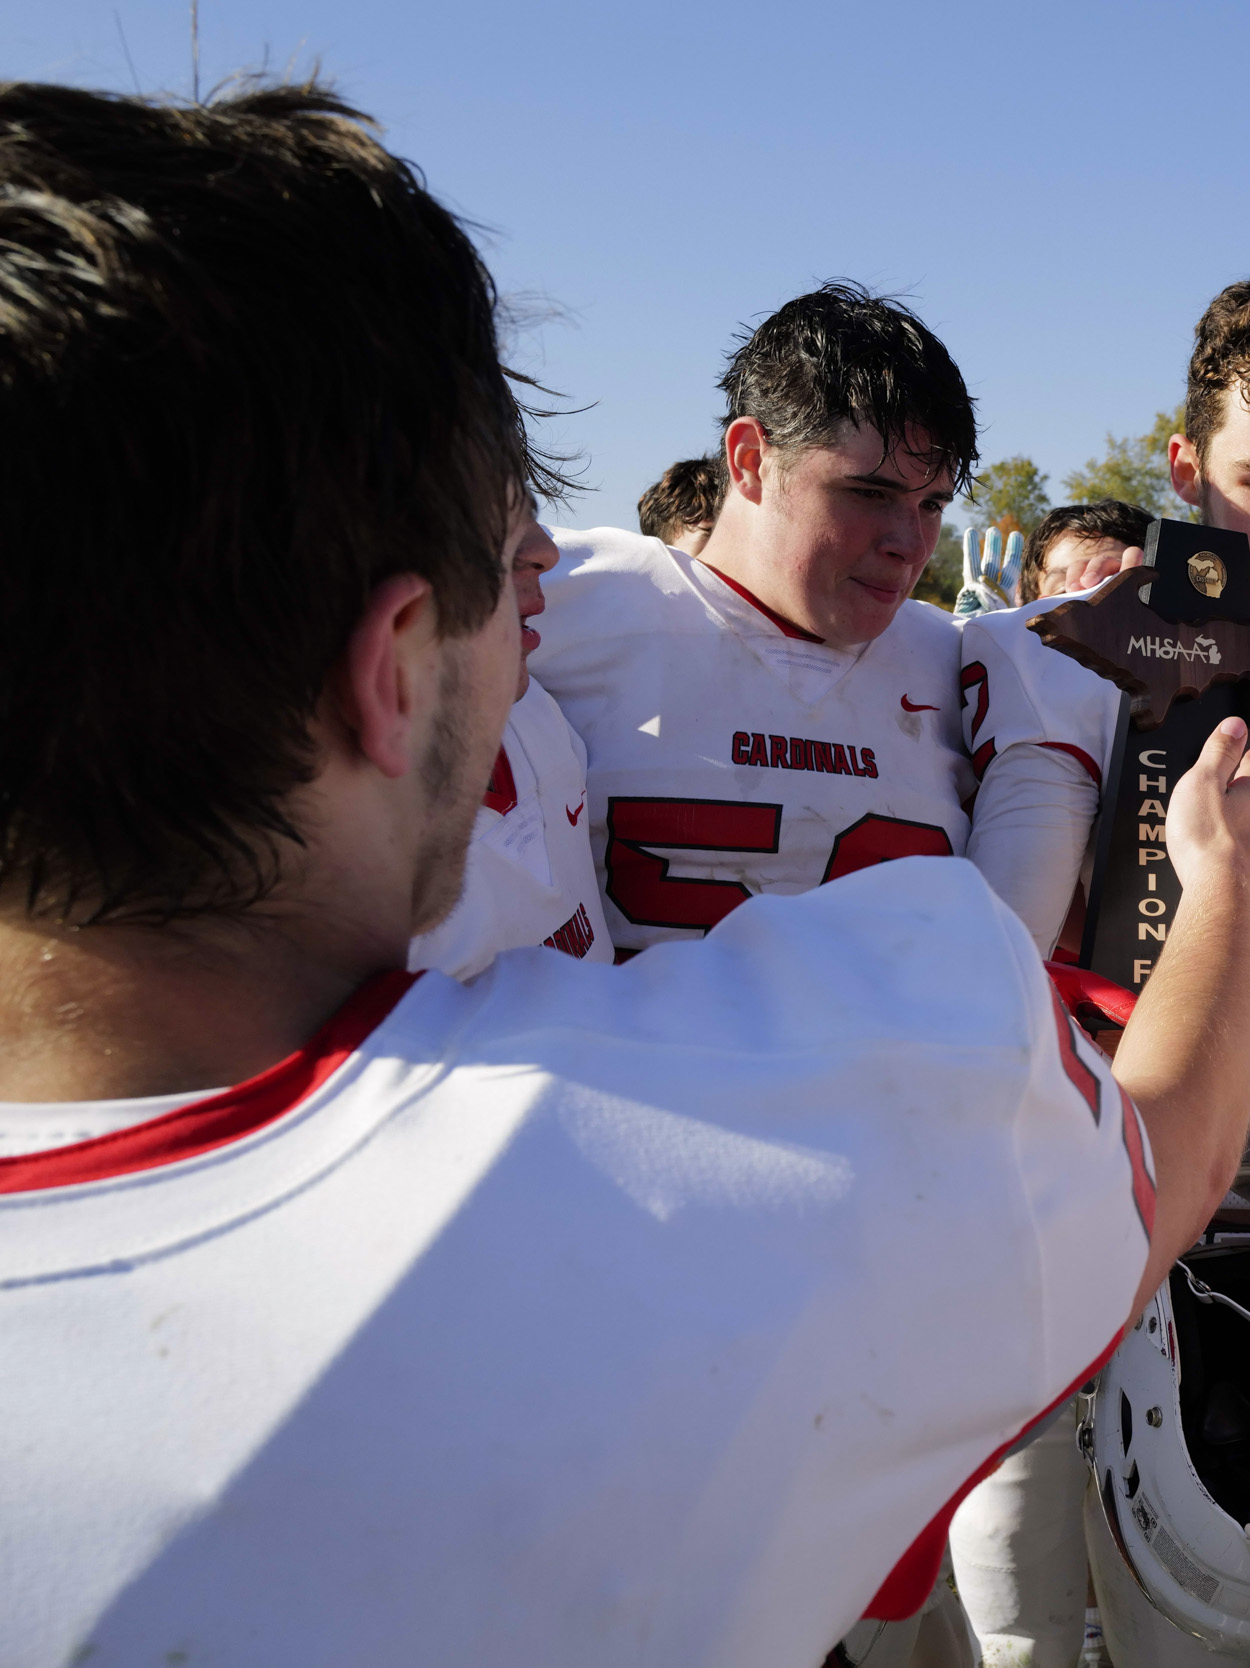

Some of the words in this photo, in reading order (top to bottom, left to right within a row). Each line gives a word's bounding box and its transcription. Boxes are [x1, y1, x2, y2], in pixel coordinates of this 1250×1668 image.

[1127, 635, 1208, 663] MHSAA
[731, 731, 879, 779] CARDINALS
[1138, 750, 1167, 941] CHAMPION
